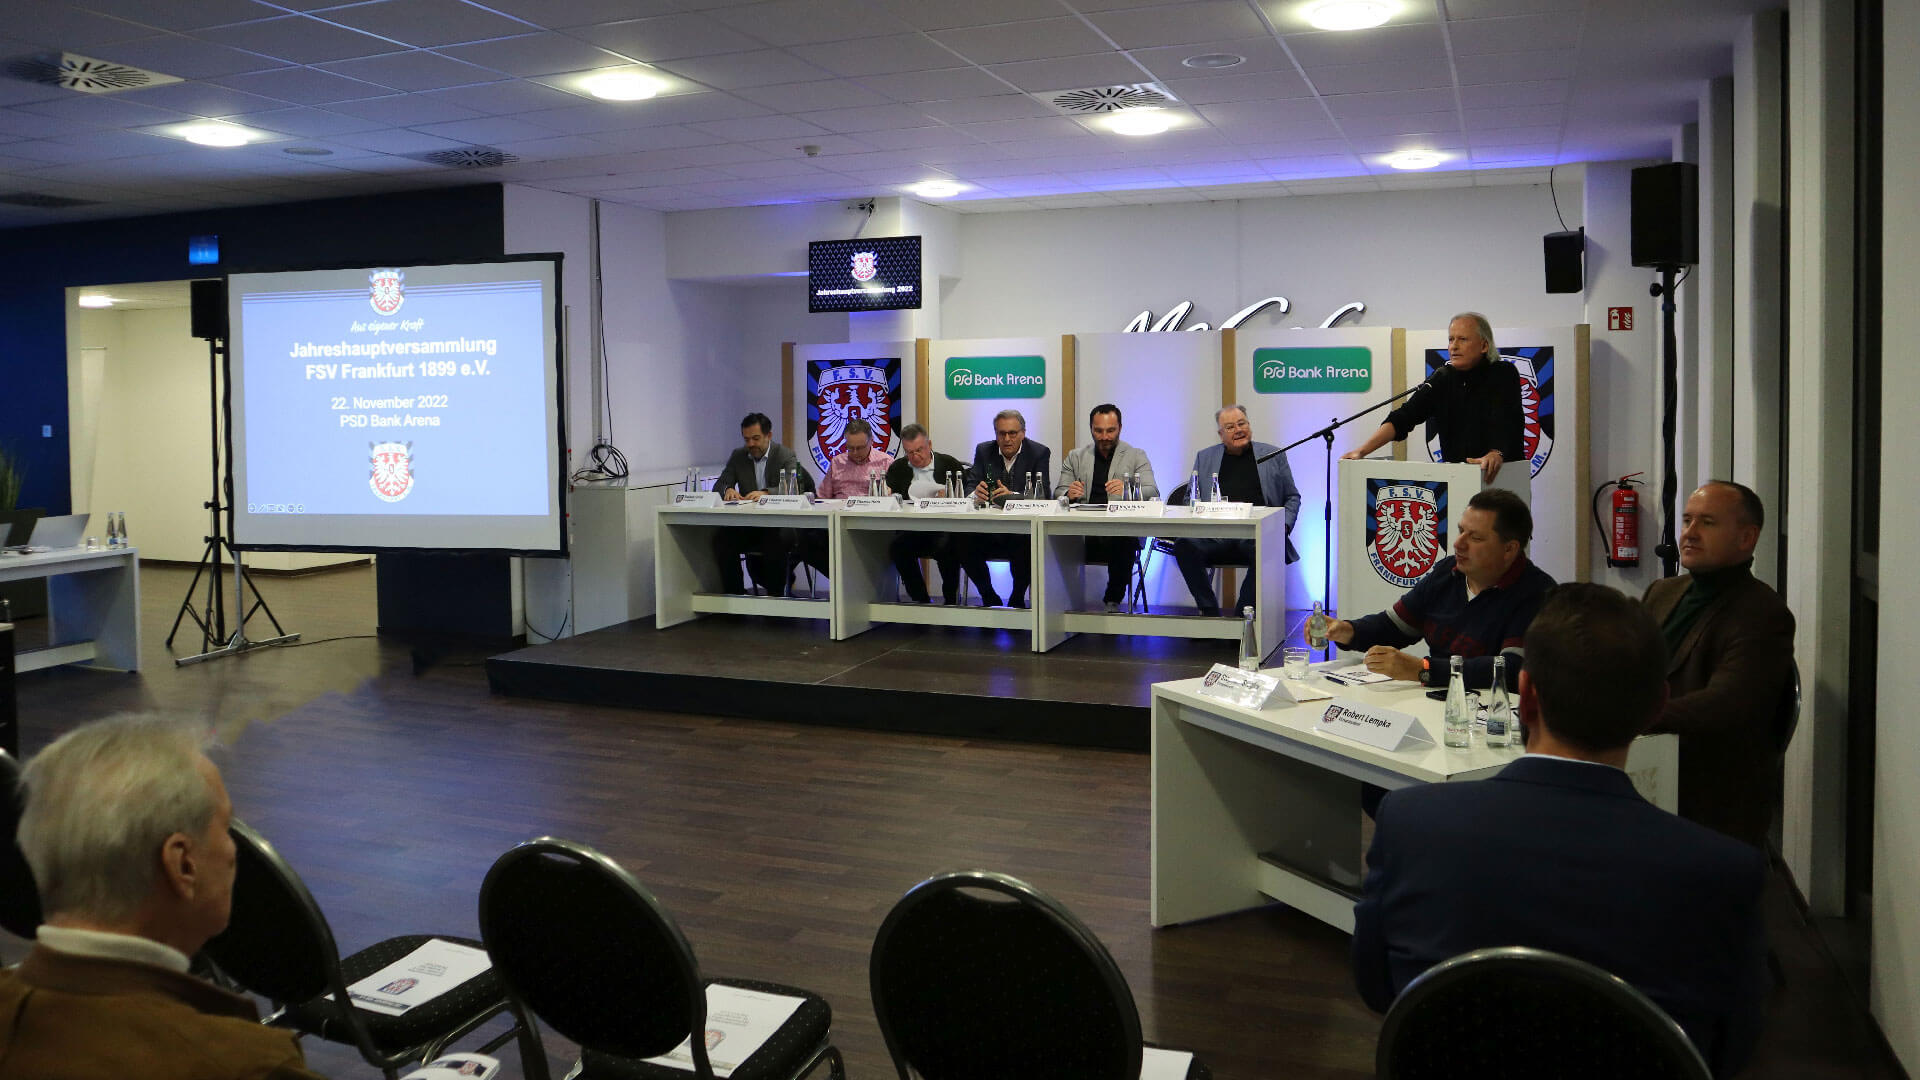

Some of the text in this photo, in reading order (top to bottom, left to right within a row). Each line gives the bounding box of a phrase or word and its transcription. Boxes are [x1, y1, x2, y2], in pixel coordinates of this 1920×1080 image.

[400, 317, 424, 333] Kraft
[289, 337, 497, 359] Jahreshauptversammlung
[306, 359, 491, 380] FSV Frankfurt 1899 e.V.
[1288, 366, 1323, 379] Bank
[1326, 365, 1368, 378] Arena
[975, 373, 1004, 386] Bank
[1007, 373, 1043, 385] Arena
[331, 394, 449, 410] 22. November 2022
[340, 413, 441, 427] PSD Bank Arena
[1342, 708, 1365, 721] Robert
[1365, 715, 1392, 728] Lempka
